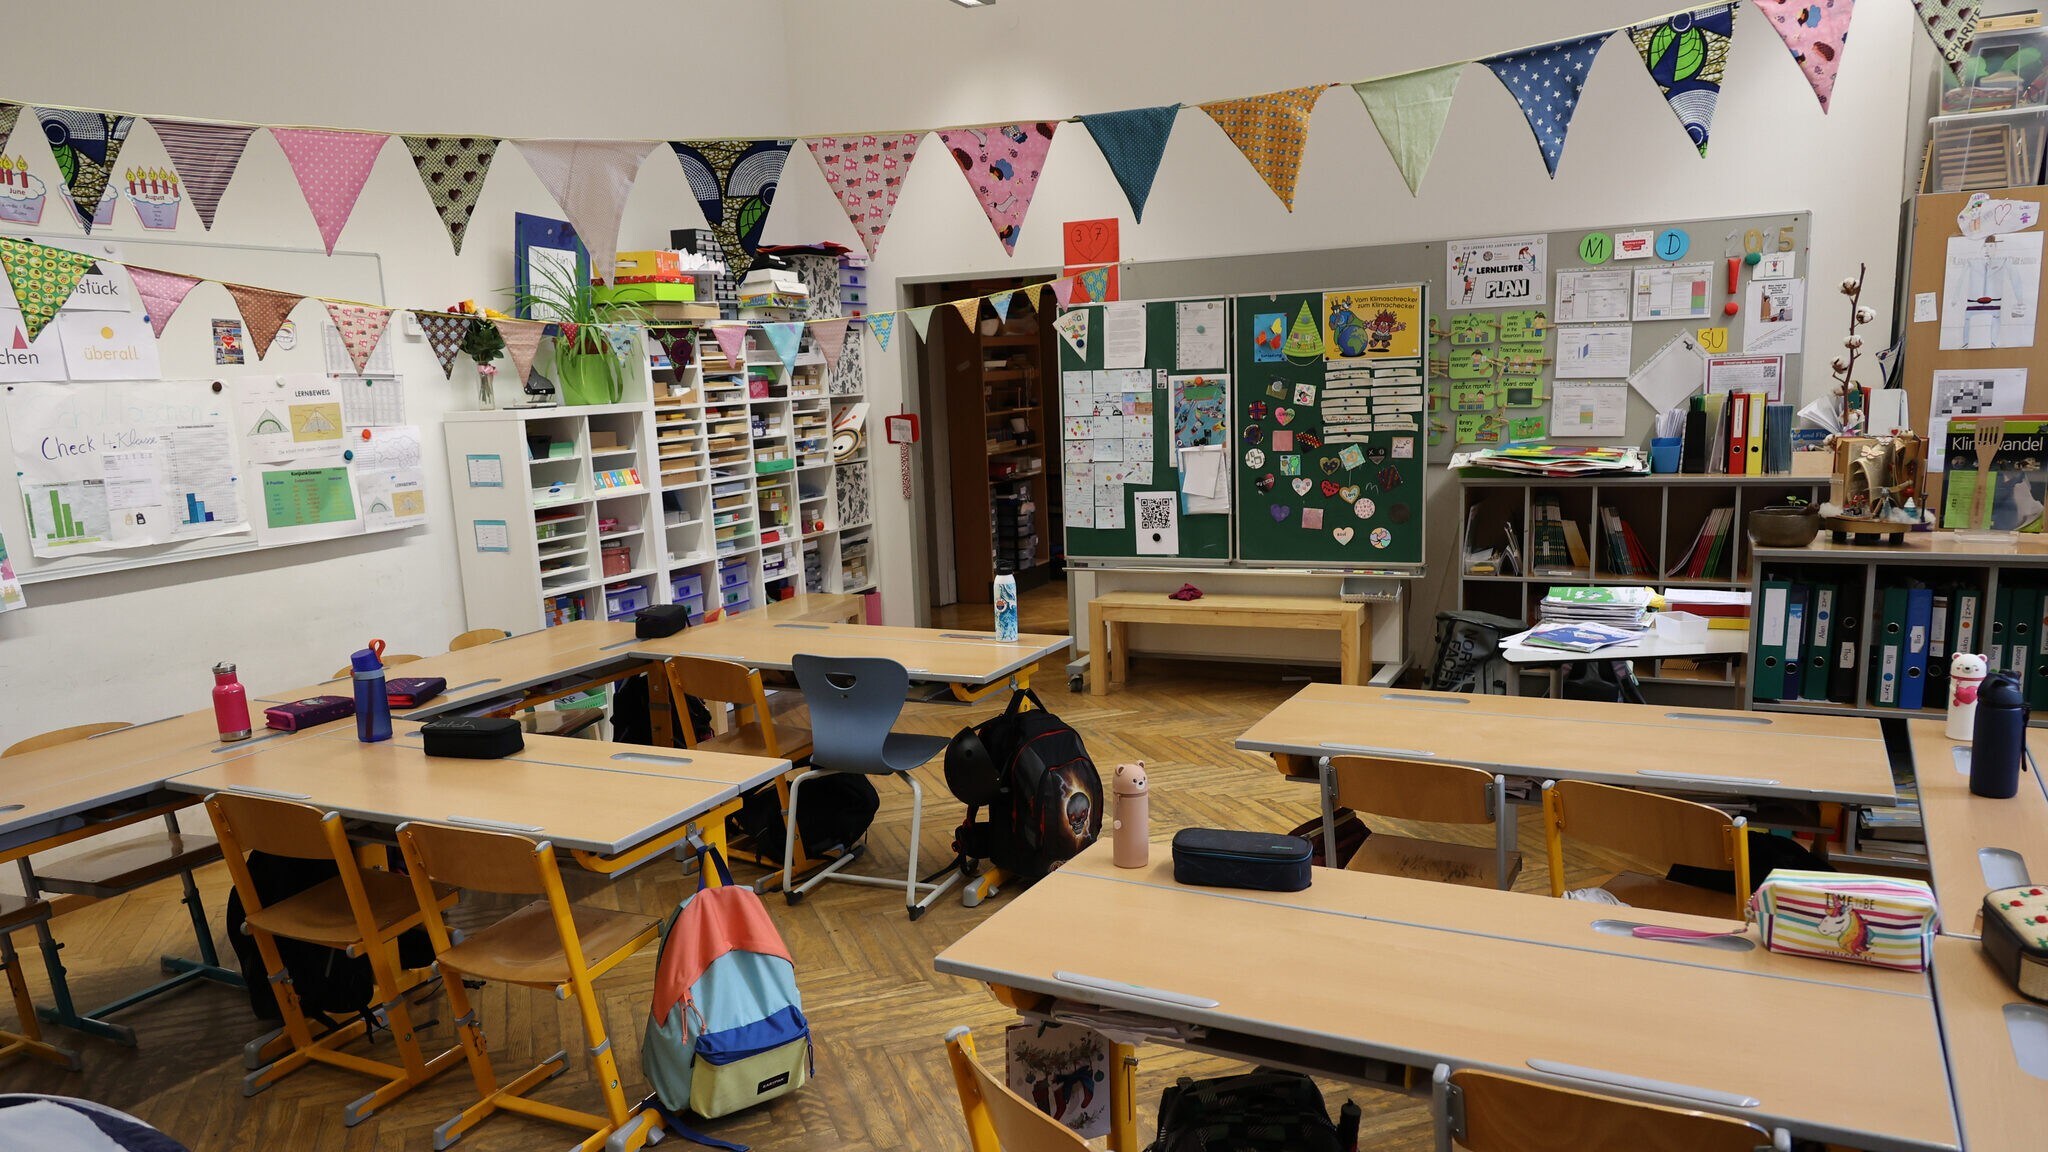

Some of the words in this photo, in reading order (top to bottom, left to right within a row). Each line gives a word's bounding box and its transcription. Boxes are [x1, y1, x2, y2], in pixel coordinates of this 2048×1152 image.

[9, 187, 26, 195] June
[1585, 238, 1603, 259] M
[1665, 233, 1681, 255] D
[1476, 264, 1524, 275] LERNLEITER
[1485, 279, 1530, 299] PLAN
[1369, 295, 1418, 303] Klimaschrecker
[1701, 330, 1724, 349] SU
[83, 344, 140, 361] überall
[294, 389, 331, 398] LERNBEWEIS
[41, 434, 97, 460] Check
[1952, 436, 2044, 452] Kliandel
[1824, 892, 1854, 908] TME
[1863, 898, 1876, 910] BE
